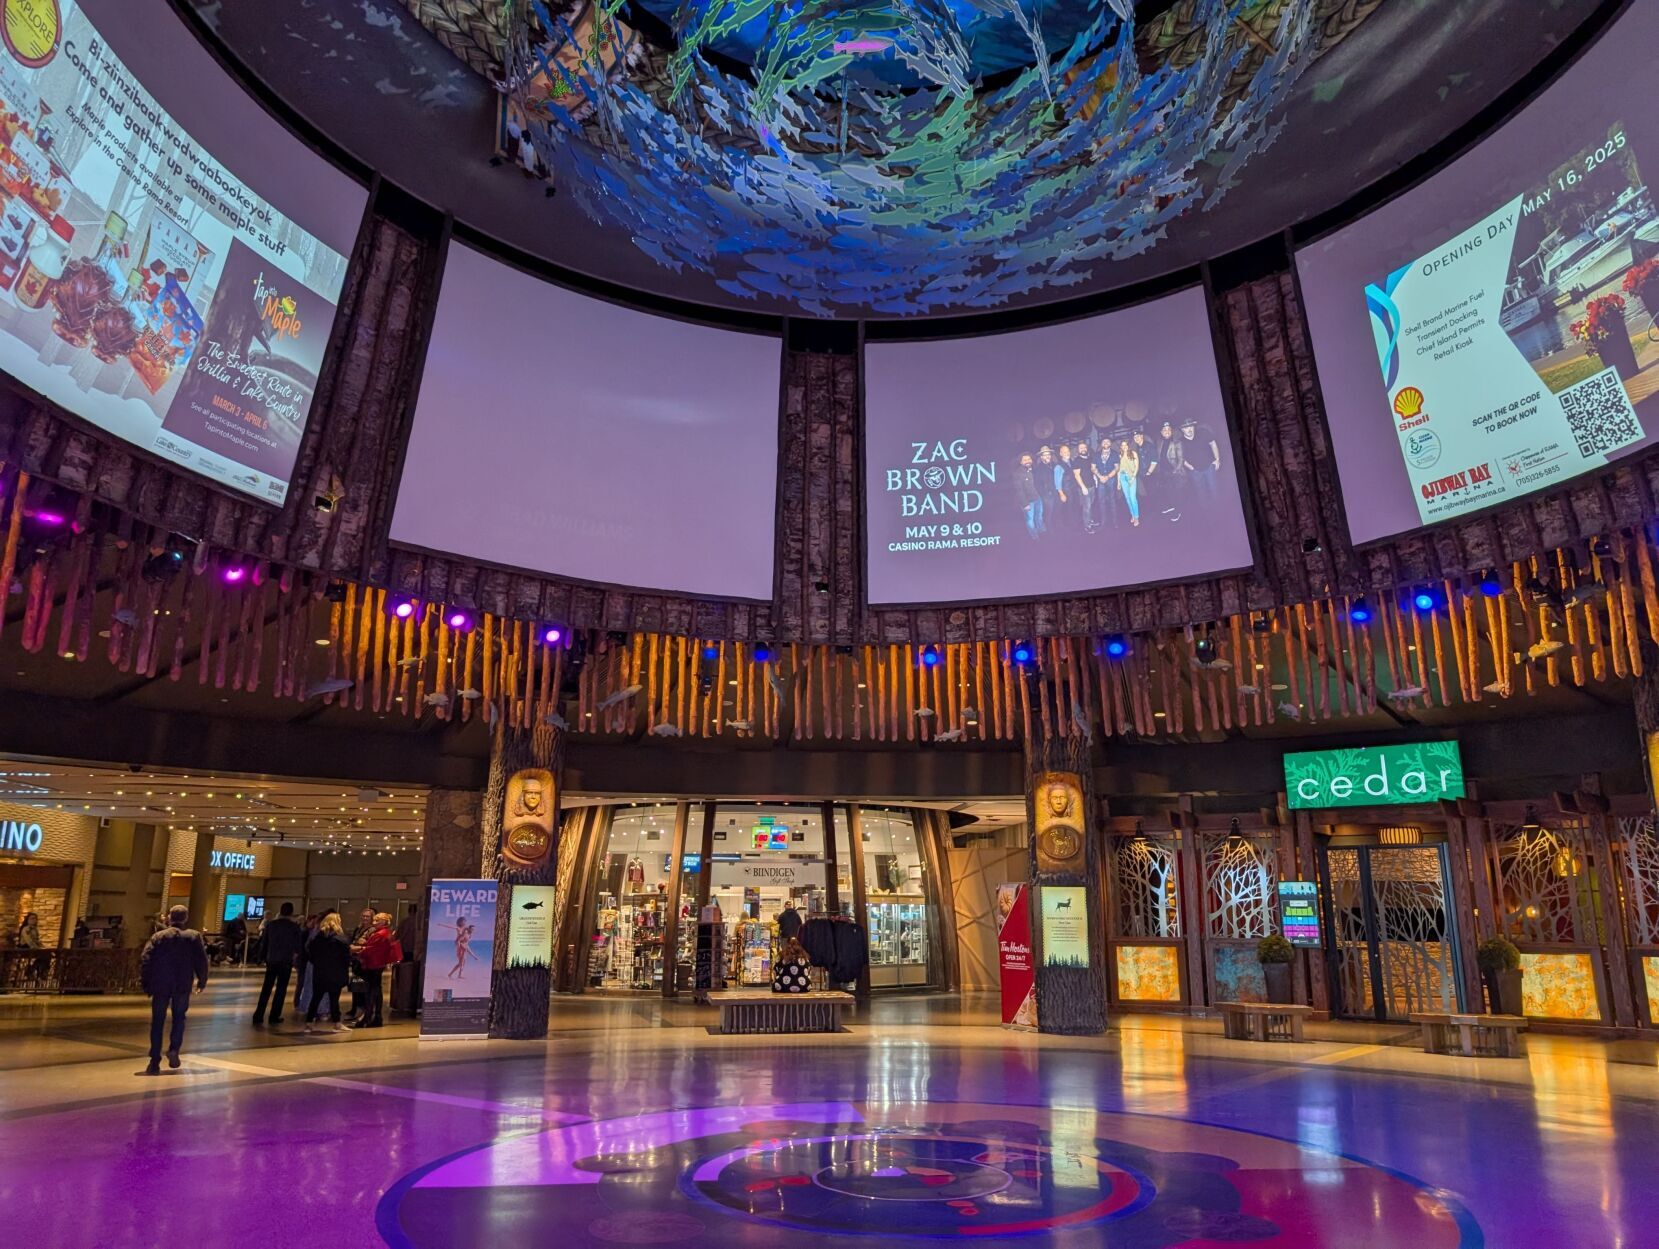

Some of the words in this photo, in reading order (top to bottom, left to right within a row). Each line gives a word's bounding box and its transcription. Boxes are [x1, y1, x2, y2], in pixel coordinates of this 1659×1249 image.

[64, 41, 97, 88] Come
[100, 87, 125, 116] and
[123, 115, 165, 157] gather
[167, 157, 183, 176] up
[185, 174, 217, 205] some
[219, 202, 256, 236] maple
[258, 233, 287, 257] stuff
[65, 105, 93, 138] Explore
[94, 135, 102, 147] in
[102, 144, 115, 160] the
[116, 158, 141, 185] Casino
[142, 182, 163, 206] Rama
[164, 202, 189, 226] Resort
[82, 103, 106, 130] Maple
[104, 130, 138, 164] products
[139, 163, 173, 196] available
[174, 195, 184, 205] at
[1422, 236, 1483, 277] OPENING
[1487, 215, 1515, 240] DAY
[1522, 188, 1552, 217] MAY
[1557, 169, 1583, 191] 16,
[1584, 130, 1627, 172] 2025
[261, 296, 301, 340] Maple
[1404, 323, 1422, 336] Shell
[1422, 313, 1443, 327] Brand
[1444, 300, 1468, 317] Marine
[1469, 289, 1485, 303] Fuel
[1416, 323, 1448, 342] Transient
[1449, 308, 1478, 327] Docking
[1416, 342, 1436, 356] Chief
[1437, 331, 1458, 347] Island
[1459, 318, 1485, 335] Permits
[1433, 346, 1454, 361] Retail
[1455, 336, 1474, 350] Kiosk
[208, 340, 224, 360] The
[267, 376, 293, 398] Route
[294, 389, 304, 404] in
[212, 394, 235, 414] MARCH
[235, 406, 242, 417] 3
[243, 411, 262, 428] APRIL
[241, 381, 264, 402] Lake
[265, 394, 301, 422] Country
[1472, 412, 1493, 427] SCAN
[1493, 406, 1507, 418] THE
[1508, 401, 1519, 412] QR
[1520, 391, 1541, 406] CODE
[191, 401, 202, 413] See
[202, 408, 210, 416] all
[209, 412, 246, 435] participating
[246, 429, 271, 445] locations
[1399, 413, 1430, 432] Shell
[1484, 424, 1496, 434] TO
[1496, 414, 1518, 430] BOOK
[1518, 405, 1537, 420] NOW
[911, 439, 968, 464] ZAC
[886, 461, 996, 491] BROWN
[1467, 462, 1492, 485] BAY
[901, 490, 983, 517] BAND
[888, 541, 926, 552] CASINO
[928, 539, 959, 550] RAMA
[960, 536, 1001, 548] RESORT
[905, 525, 938, 539] MAY
[940, 524, 950, 537] 9
[952, 523, 964, 536] &
[966, 522, 982, 535] 10
[1297, 754, 1451, 800] cedar
[224, 852, 256, 870] OFFICE
[431, 889, 498, 903] REWARD
[446, 904, 481, 918] LIFE
[1000, 941, 1009, 952] Tim
